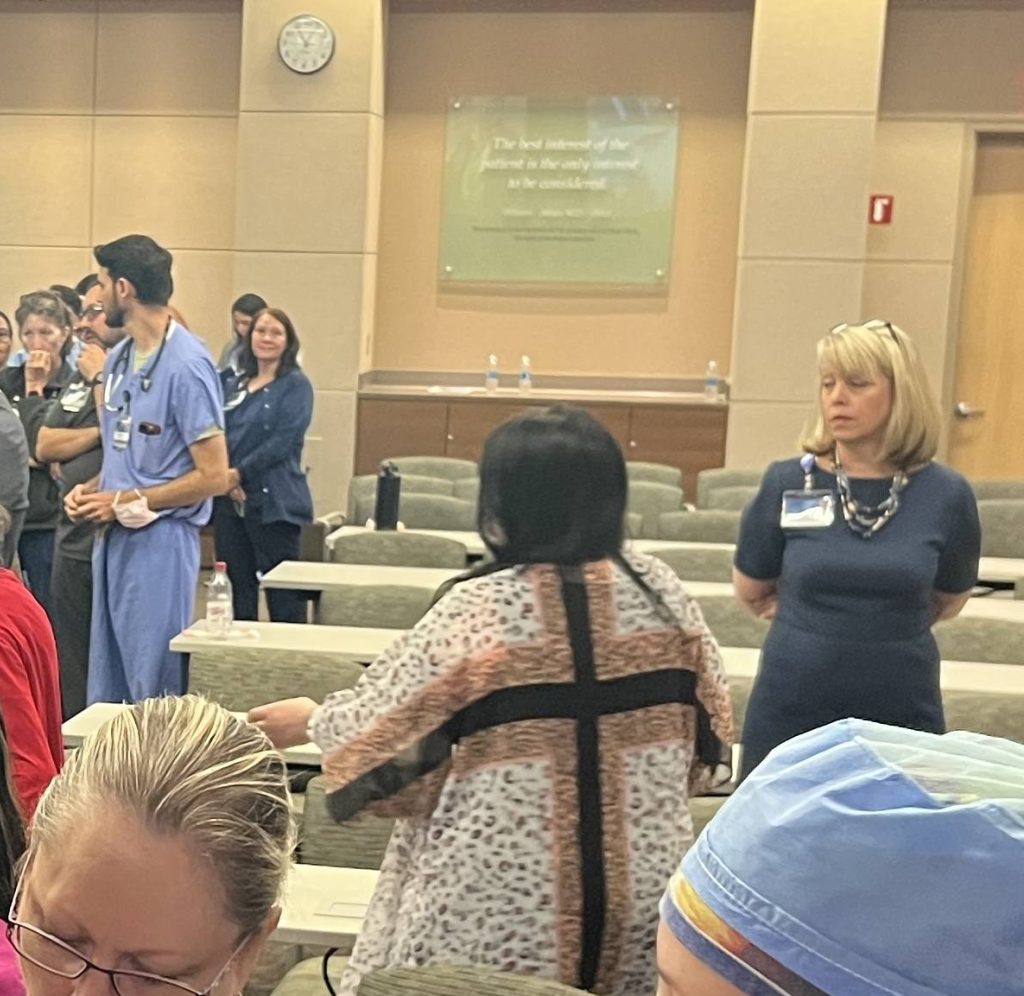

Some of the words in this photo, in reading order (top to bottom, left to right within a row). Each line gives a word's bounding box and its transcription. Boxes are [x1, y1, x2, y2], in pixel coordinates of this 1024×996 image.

[494, 137, 517, 150] The
[518, 137, 542, 150] best
[593, 138, 608, 153] of
[609, 138, 629, 150] the
[540, 157, 560, 170] the
